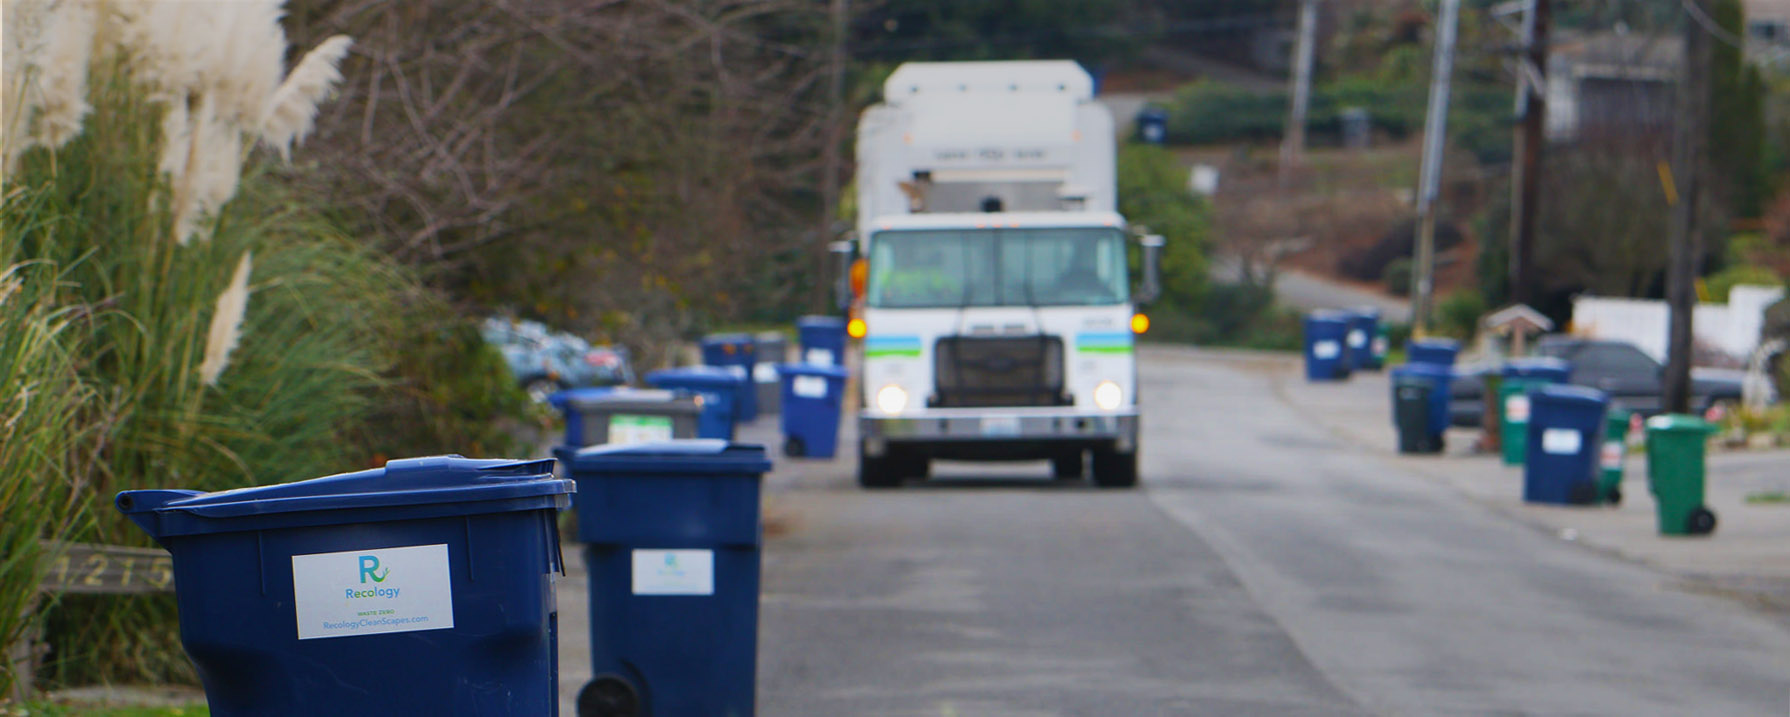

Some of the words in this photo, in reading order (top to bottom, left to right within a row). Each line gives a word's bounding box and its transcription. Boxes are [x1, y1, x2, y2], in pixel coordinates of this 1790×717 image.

[358, 555, 391, 584] R
[345, 587, 400, 599] Recology
[323, 616, 428, 629] RecologyCleanScapes.com
